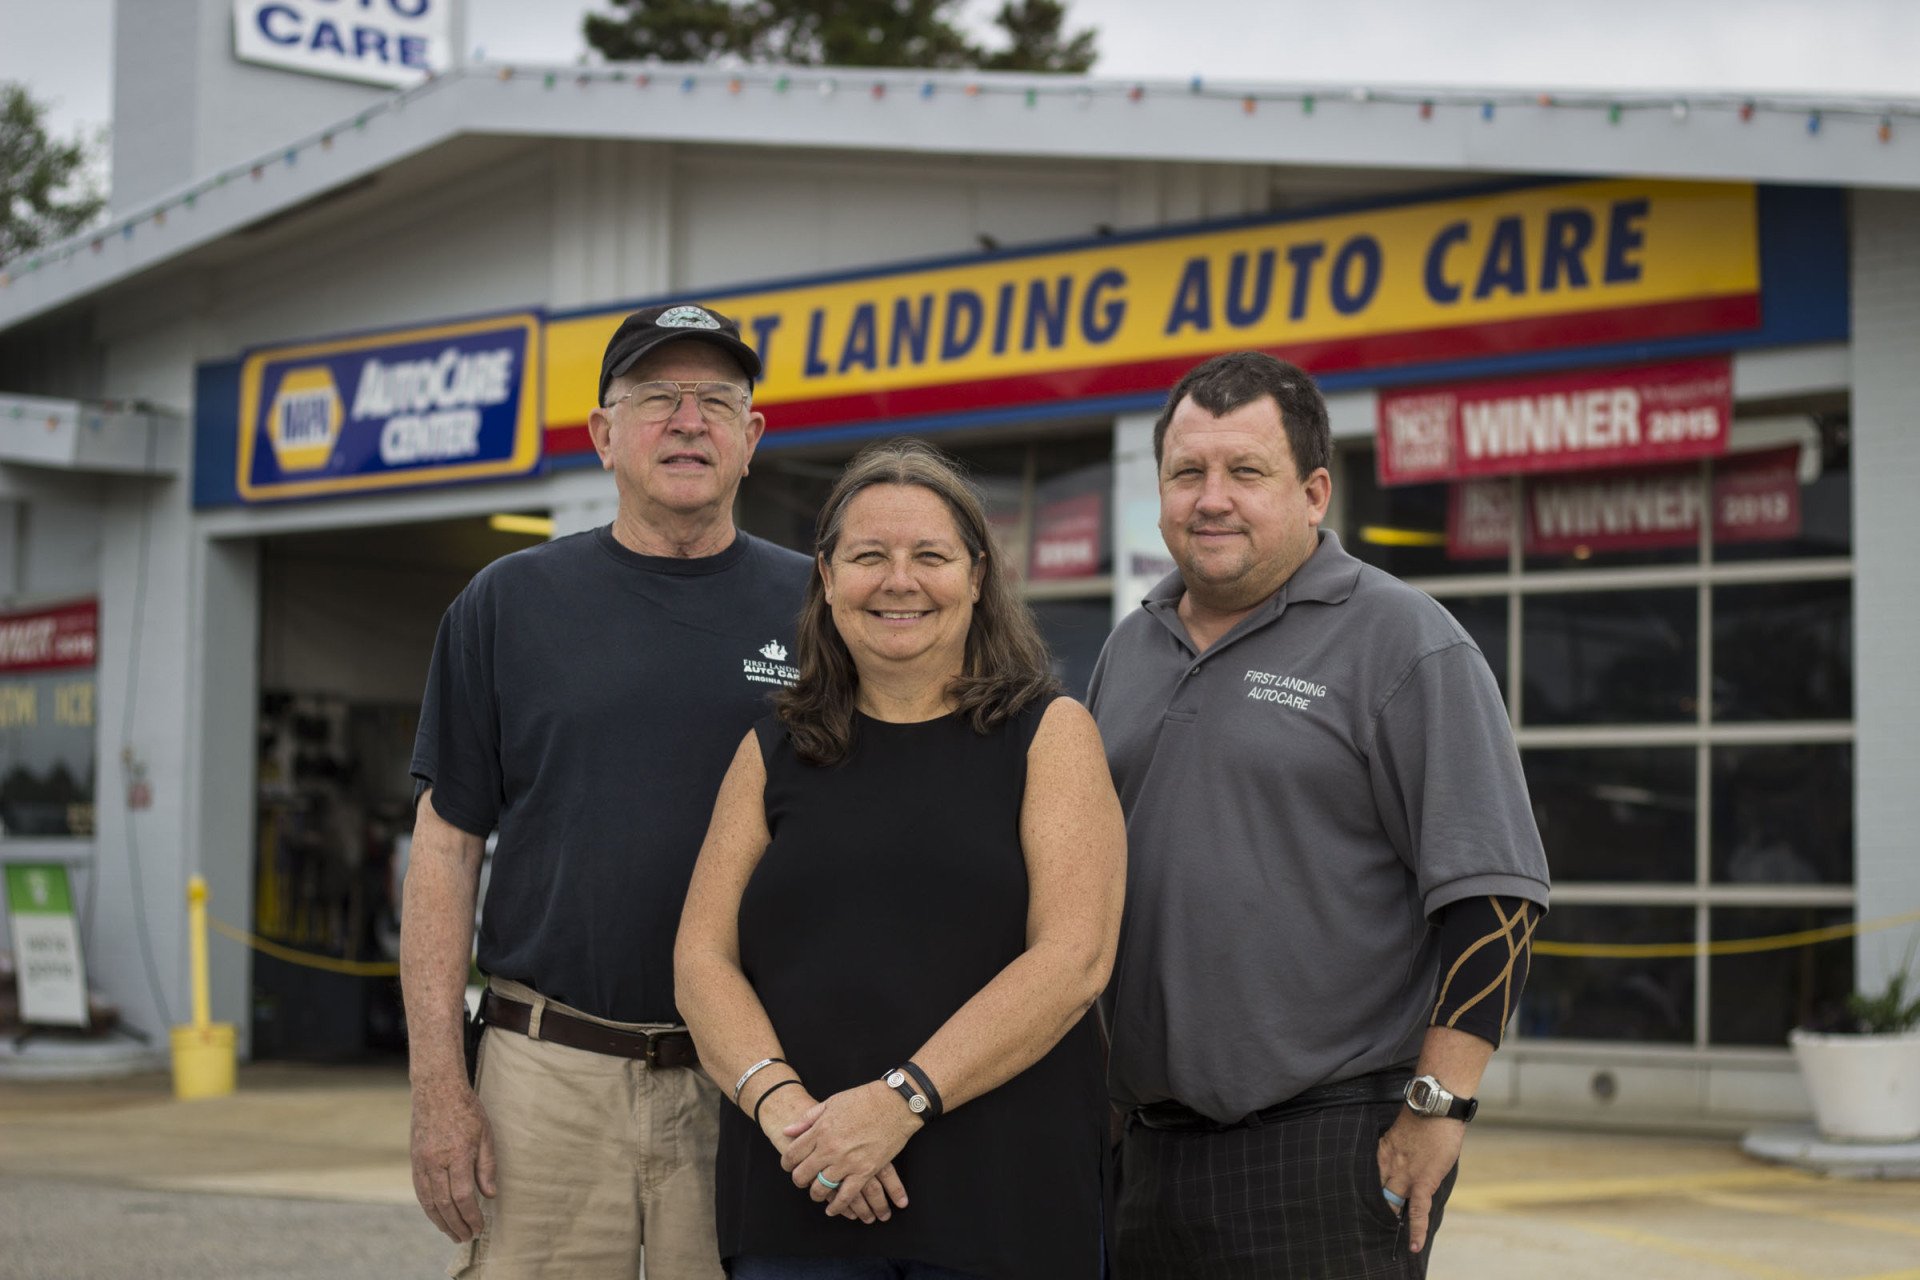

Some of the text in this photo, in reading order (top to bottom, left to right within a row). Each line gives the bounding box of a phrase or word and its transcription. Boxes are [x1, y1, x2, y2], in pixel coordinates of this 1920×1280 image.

[256, 5, 429, 70] CARE
[804, 269, 1128, 378] LANDING
[1163, 234, 1384, 336] AUTO
[1423, 198, 1651, 306] CARE
[382, 411, 480, 463] CENTER
[1462, 389, 1641, 458] WINNER
[743, 659, 800, 674] FIRST LANDIN
[743, 666, 800, 681] AUTO CAR
[746, 675, 782, 685] VIRGINIA
[1243, 670, 1327, 698] FIRST LANDING
[1247, 686, 1311, 710] AUTOCARE
